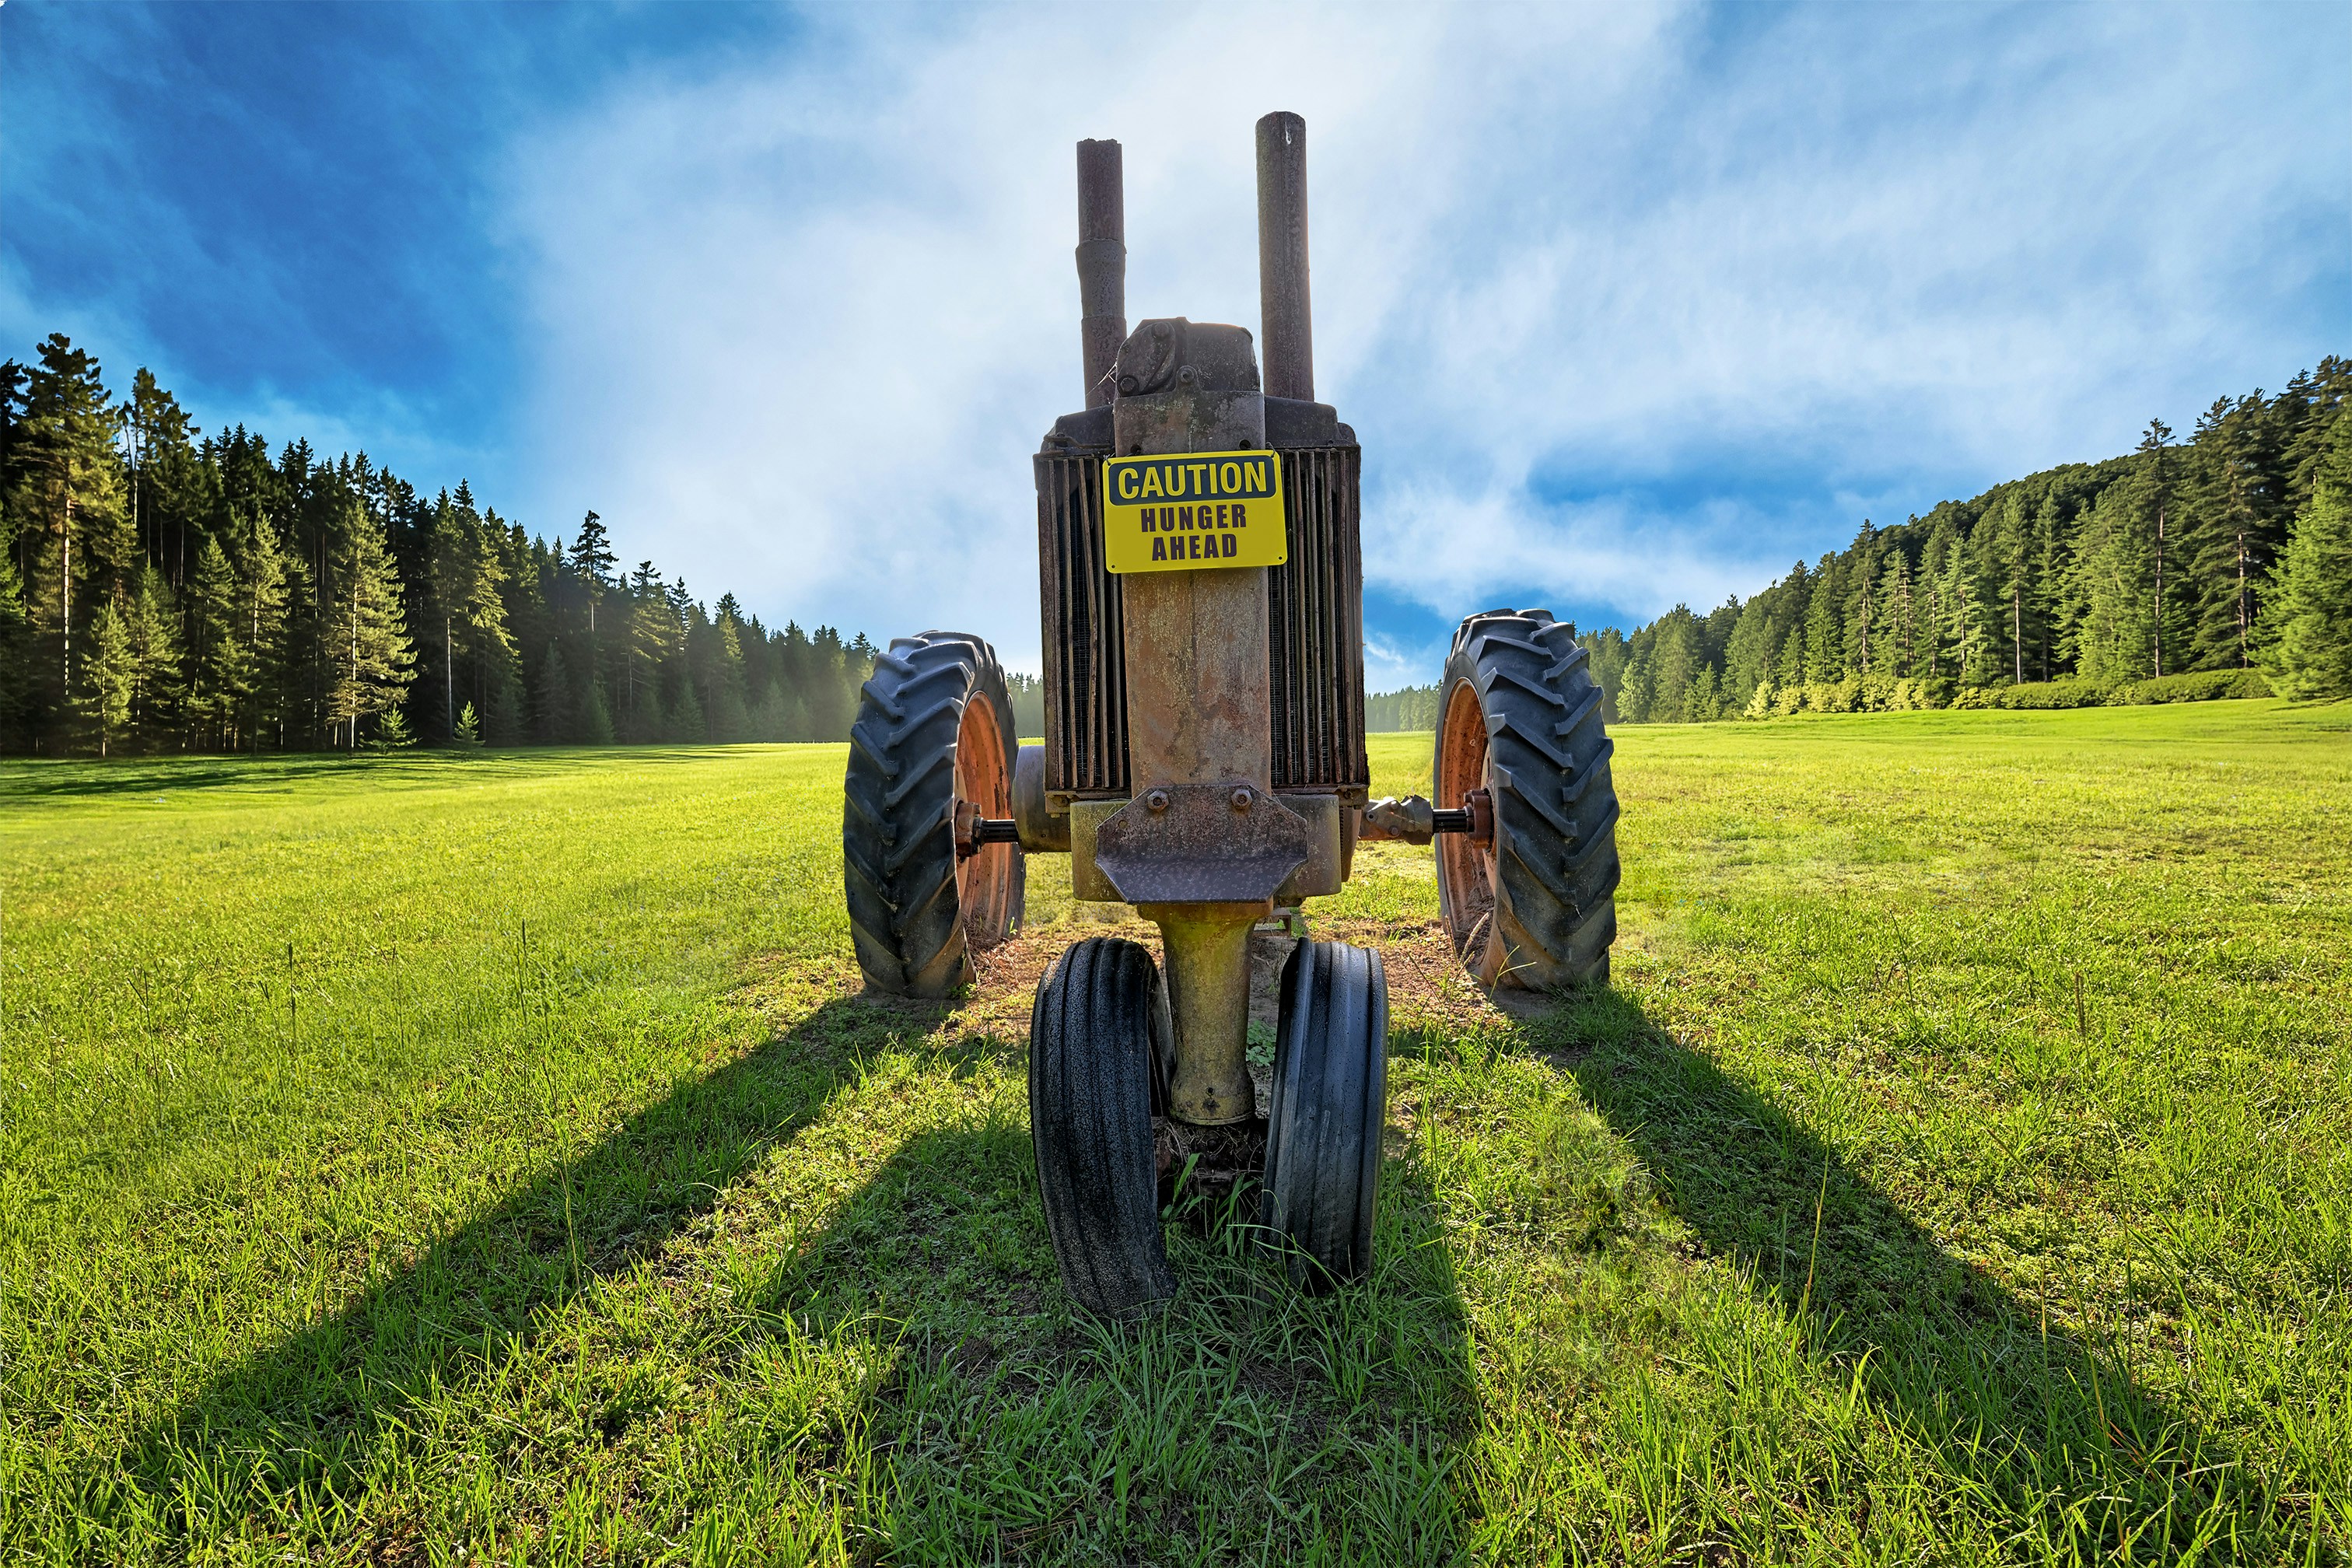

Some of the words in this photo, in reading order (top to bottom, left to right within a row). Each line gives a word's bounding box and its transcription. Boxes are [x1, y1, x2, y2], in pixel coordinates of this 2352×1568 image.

[1118, 461, 1267, 499] CAUTION
[1140, 504, 1247, 533] HUNGER
[1152, 534, 1237, 562] AHEAD
